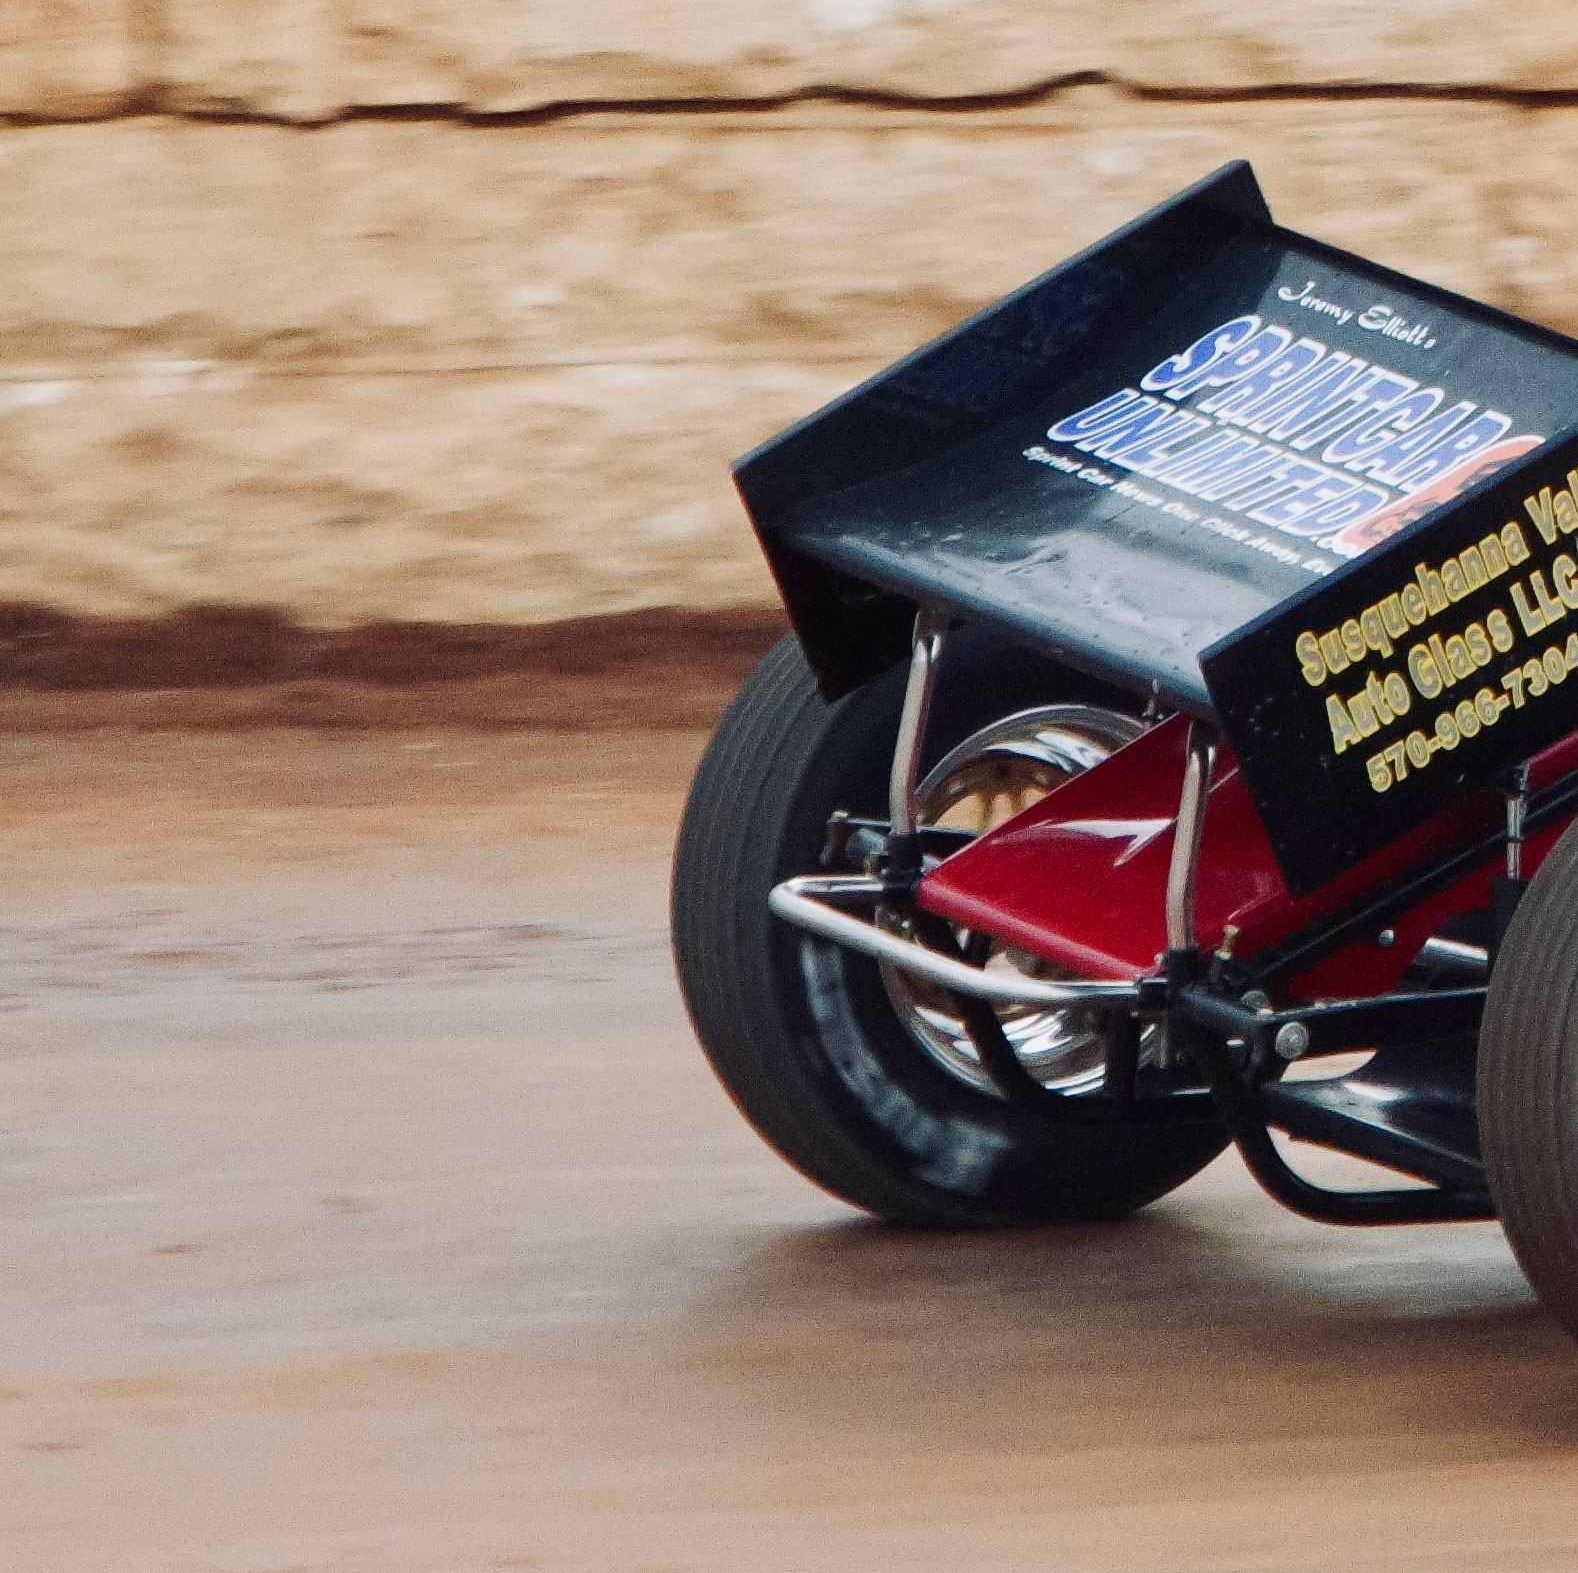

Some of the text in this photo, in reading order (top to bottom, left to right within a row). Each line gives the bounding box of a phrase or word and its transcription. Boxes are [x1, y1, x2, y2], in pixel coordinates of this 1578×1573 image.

[1046, 386, 1391, 537] UNLIMITED
[1139, 313, 1513, 495] SPRINTCAR
[1295, 521, 1531, 687] Susquehanna
[1325, 670, 1411, 755] Auto
[1408, 609, 1514, 699] Glass
